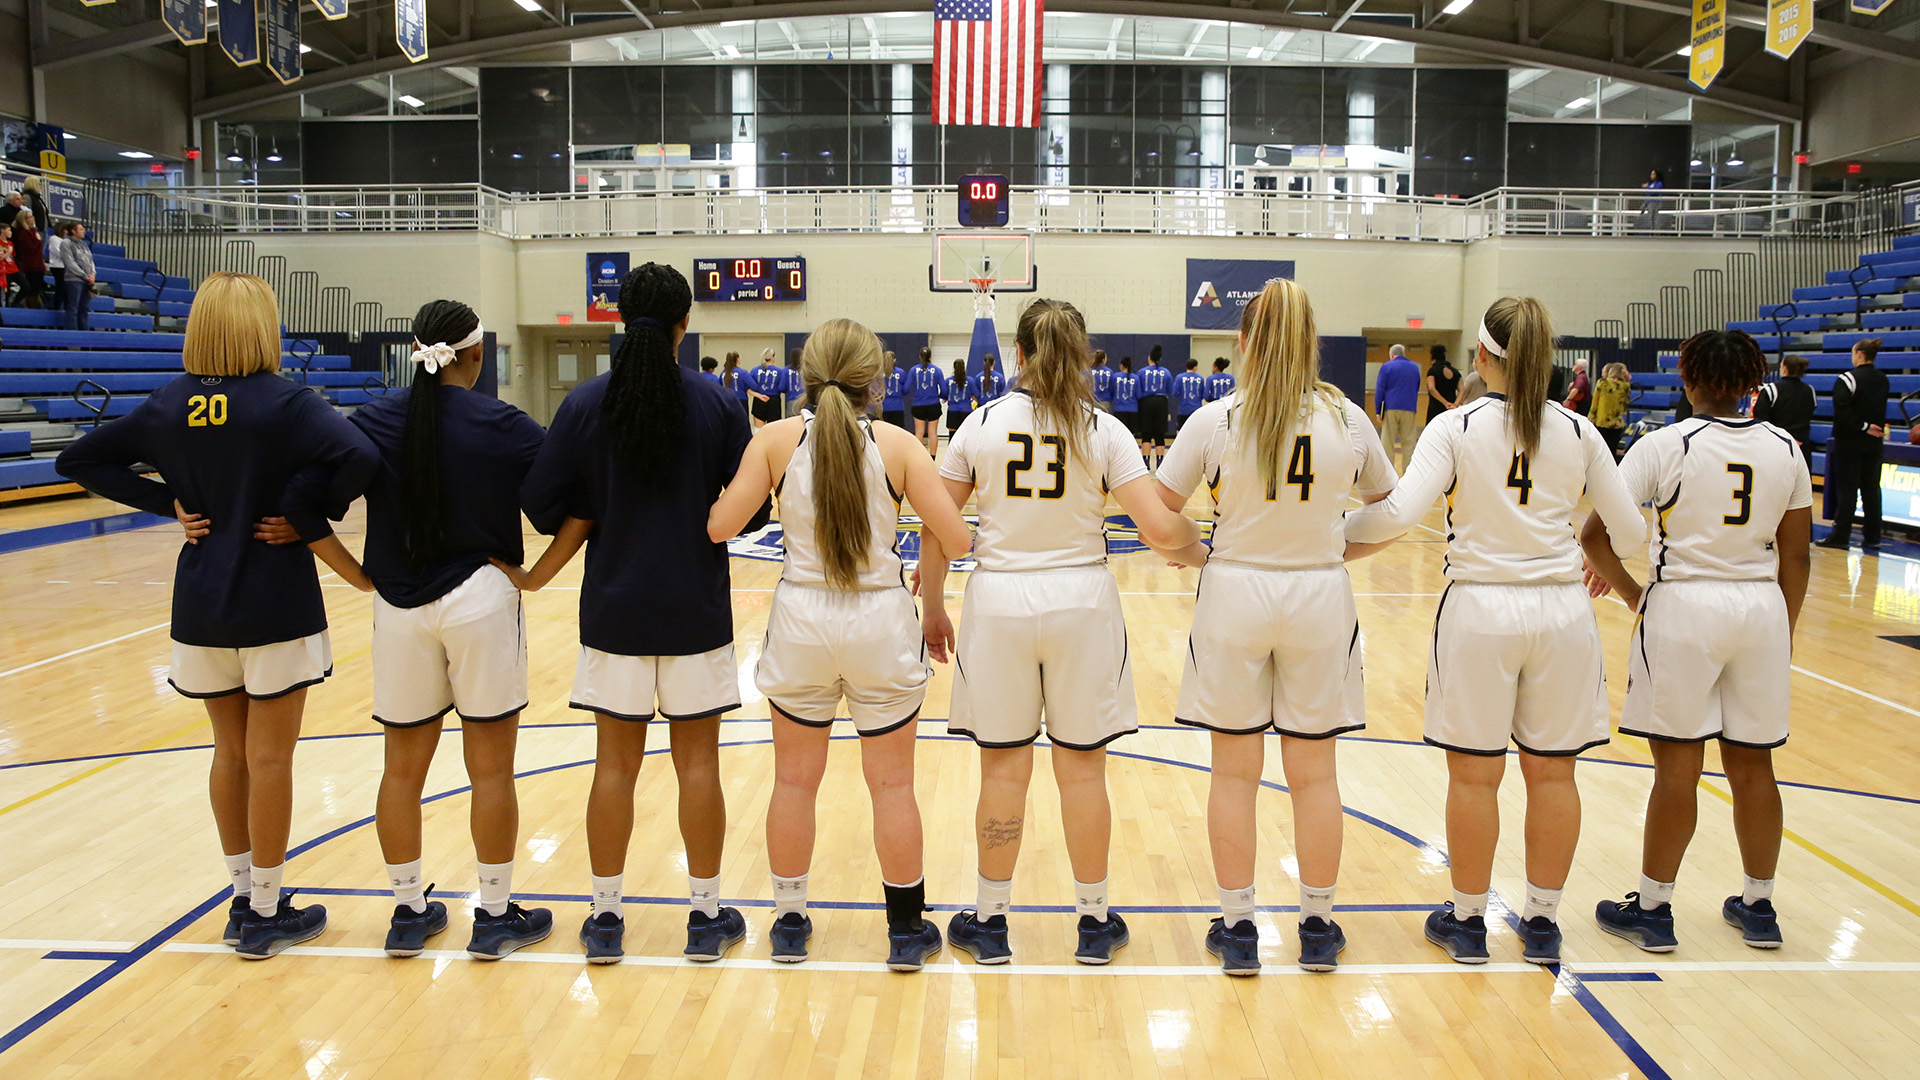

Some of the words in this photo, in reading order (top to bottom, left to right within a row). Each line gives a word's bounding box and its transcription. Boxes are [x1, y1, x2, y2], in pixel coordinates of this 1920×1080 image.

[1779, 4, 1799, 25] 2015
[1778, 23, 1798, 44] 2016
[970, 182, 997, 200] 0.0
[62, 199, 75, 216] G
[698, 261, 717, 270] Home
[735, 260, 761, 279] 0.0
[777, 260, 800, 270] Guests
[709, 271, 720, 290] 0
[790, 270, 801, 289] 0
[737, 288, 758, 299] period
[764, 285, 773, 300] 0
[1226, 290, 1258, 299] ATLANT
[188, 394, 228, 427] 20
[1005, 431, 1068, 500] 23
[1264, 433, 1316, 503] 4
[1505, 442, 1534, 507] 4
[1722, 461, 1755, 527] 3
